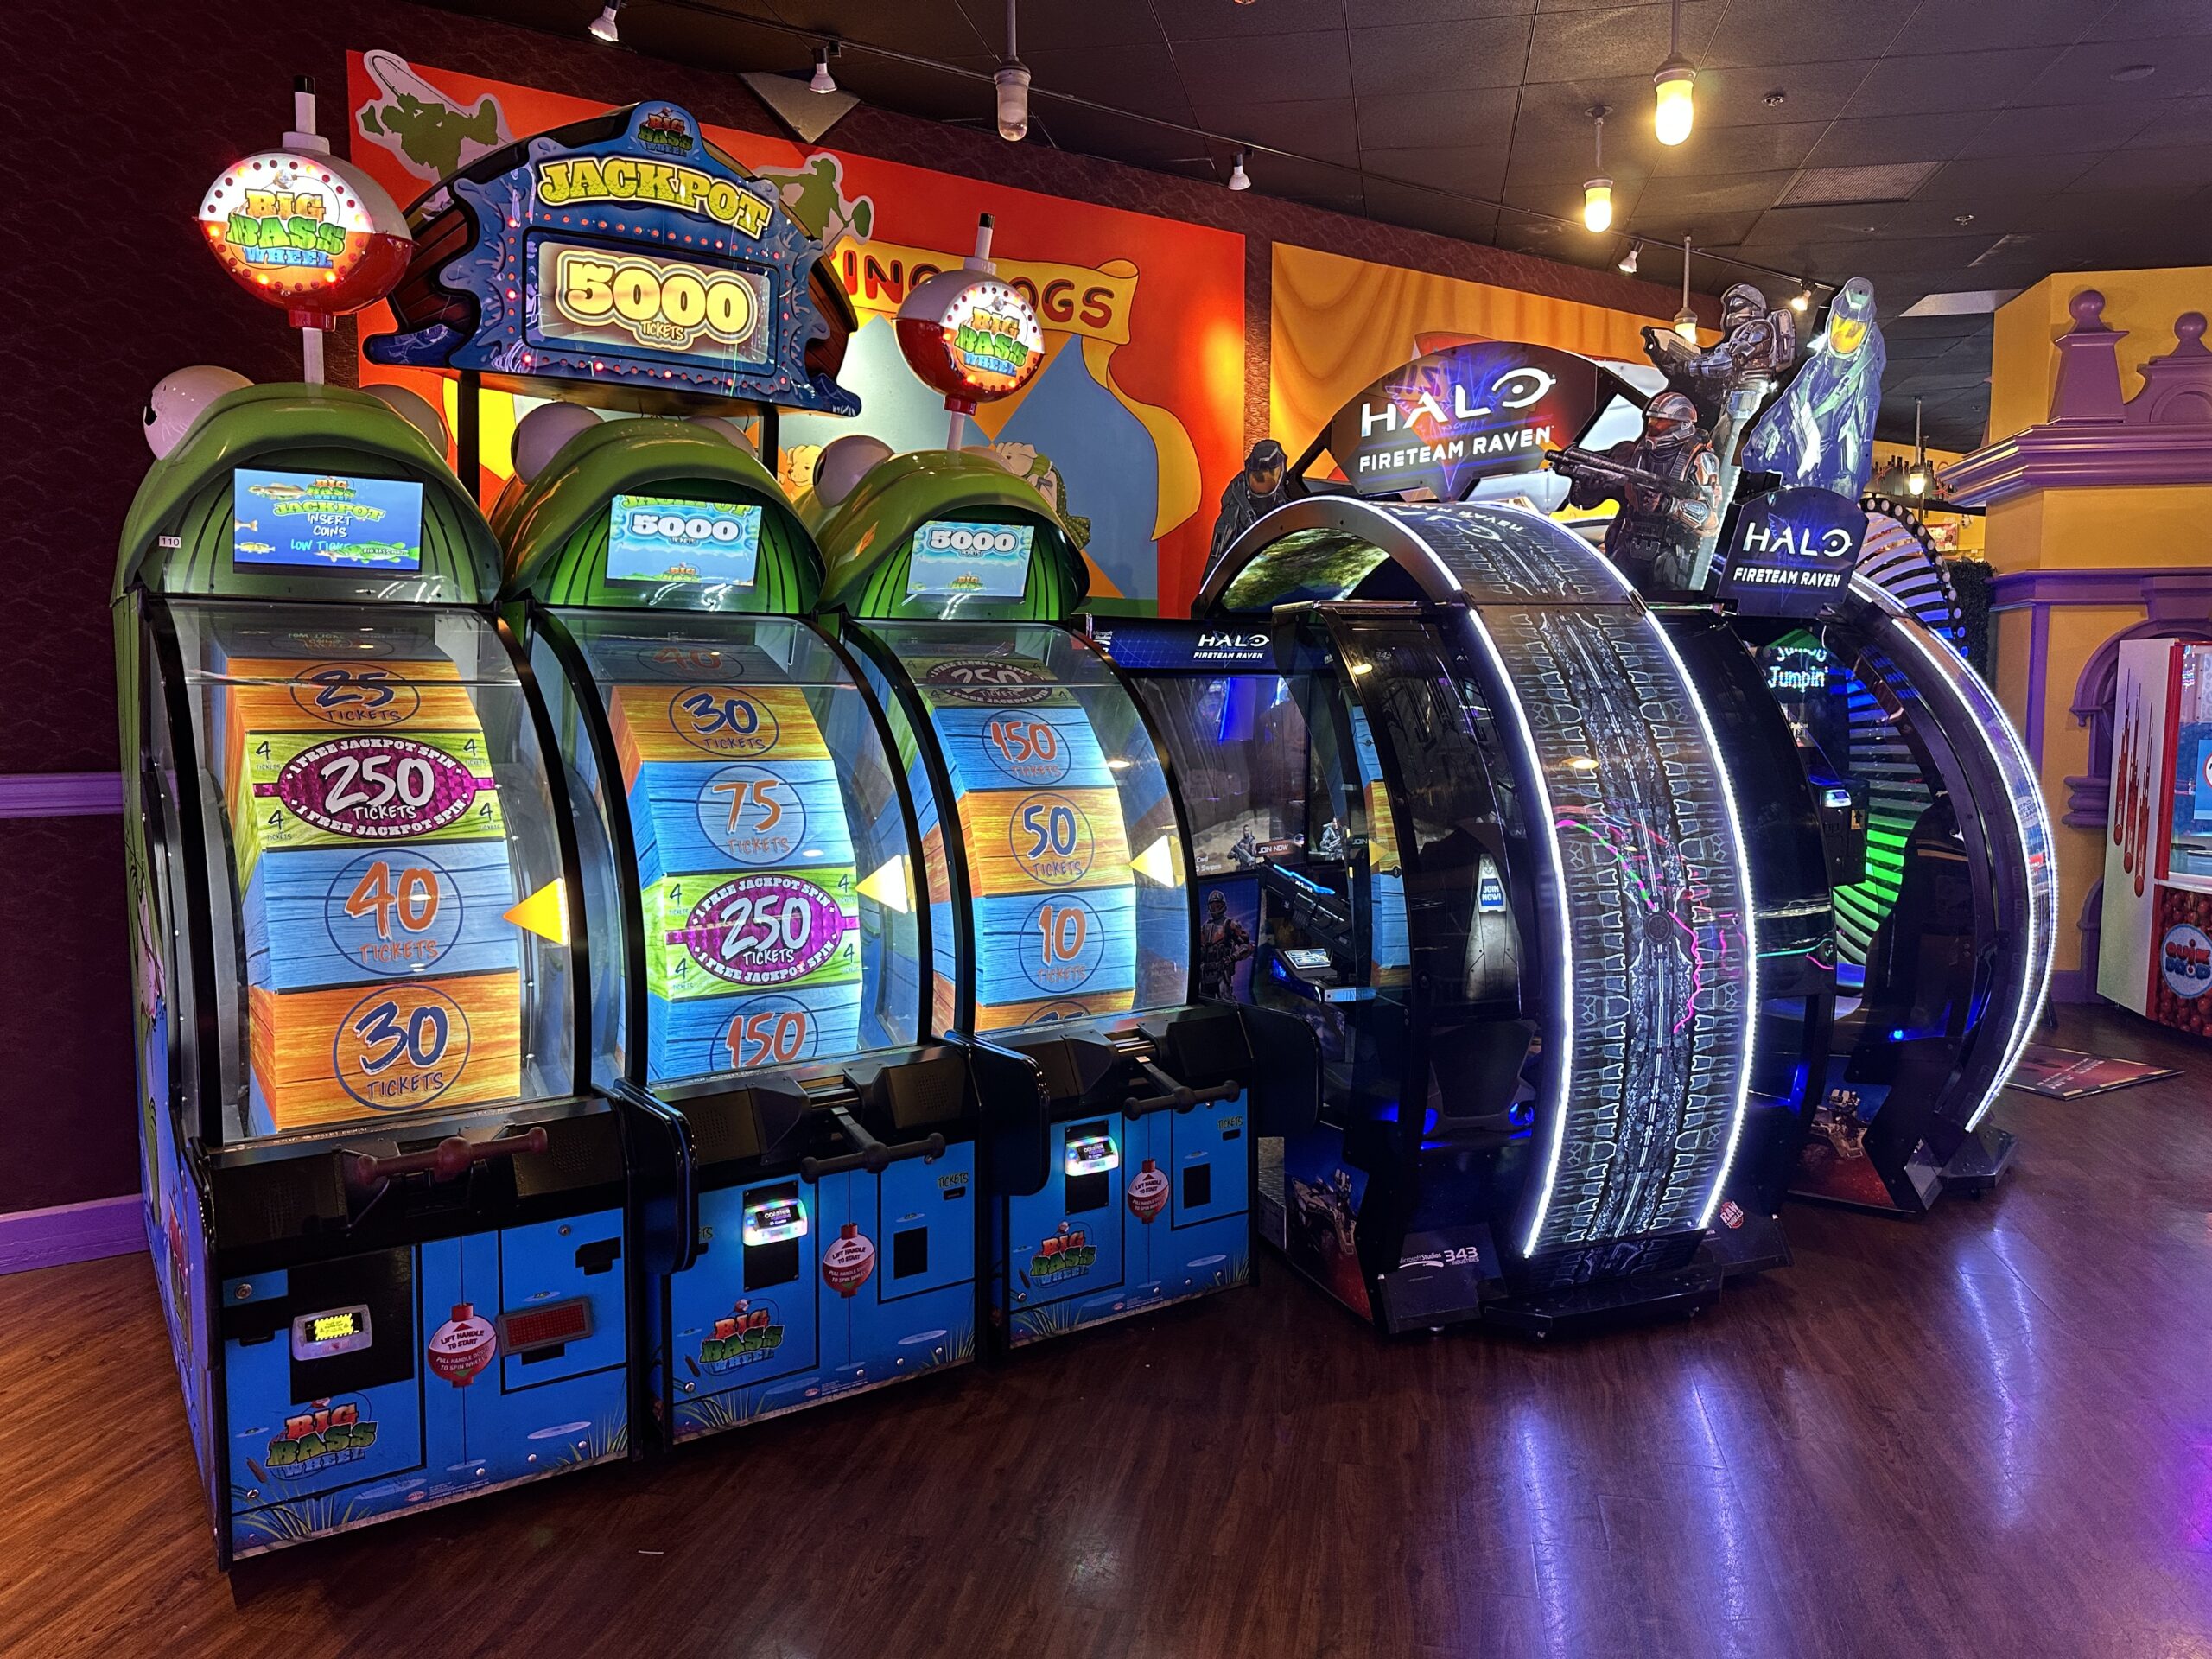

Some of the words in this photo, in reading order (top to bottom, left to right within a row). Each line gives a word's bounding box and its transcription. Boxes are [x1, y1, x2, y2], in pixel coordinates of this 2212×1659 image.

[648, 113, 685, 134] BIG
[638, 125, 693, 151] BASS
[645, 142, 687, 157] WHEEL
[245, 188, 327, 219] BIG
[540, 159, 772, 238] JACKPOT
[226, 213, 346, 256] BASS
[243, 247, 333, 269] WHEEL
[566, 261, 749, 333] 5000
[640, 321, 685, 340] TICKETS
[970, 307, 1020, 340] BIG
[955, 323, 1029, 367] BASS
[963, 353, 1017, 377] WHEEL
[1361, 367, 1556, 437] HALO
[1360, 440, 1465, 473] FIRETEAM
[1472, 426, 1552, 455] RAVEN
[273, 500, 386, 522] JACKPOT
[308, 512, 353, 526] INSERT
[313, 525, 347, 537] COINS
[632, 514, 739, 541] 5000
[162, 537, 179, 546] 110
[290, 539, 313, 551] LOW
[930, 530, 1016, 552] 5000
[1743, 522, 1853, 557] HALO
[1733, 567, 1797, 585] FIRETEAM
[1800, 571, 1841, 588] RAVEN
[1198, 634, 1269, 647] HALO
[652, 647, 723, 671] 40
[313, 670, 396, 708] 25
[950, 669, 1026, 692] 250
[326, 709, 402, 721] TICKETS
[682, 693, 760, 735] 30
[256, 741, 271, 760] 4
[298, 743, 338, 767] FREE
[341, 737, 416, 753] JACKPOT
[418, 746, 456, 770] SPIN
[463, 738, 478, 757] 4
[702, 737, 766, 750] TICKETS
[990, 721, 1057, 763] 150
[1011, 764, 1062, 779] TICKETS
[321, 755, 435, 815] 250
[308, 810, 353, 833] FREE
[356, 820, 434, 836] JACKPOT
[433, 799, 467, 826] SPIN
[352, 804, 417, 820] TICKETS
[479, 802, 493, 823] 4
[712, 779, 782, 835] 75
[267, 810, 284, 830] 4
[1023, 804, 1077, 861] 50
[727, 836, 791, 855] TICKETS
[1033, 861, 1084, 879] TICKETS
[669, 883, 683, 906] 4
[704, 883, 738, 910] FREE
[738, 877, 801, 891] JACKPOT
[801, 884, 830, 908] SPIN
[837, 873, 850, 893] 4
[344, 861, 441, 940] 40
[720, 895, 812, 963] 250
[1039, 905, 1087, 966] 10
[359, 939, 439, 963] TICKETS
[704, 957, 743, 981] FREE
[744, 964, 804, 982] JACKPOT
[807, 939, 836, 966] SPIN
[742, 948, 796, 967] TICKETS
[842, 942, 855, 963] 4
[674, 957, 688, 980] 4
[1037, 964, 1087, 983] TICKETS
[353, 1001, 449, 1076] 30
[725, 1011, 807, 1069] 150
[367, 1071, 446, 1099] TICKETS
[1217, 1116, 1244, 1129] TICKETS
[938, 1173, 969, 1188] TICKETS
[1719, 1200, 1739, 1224] RAW
[832, 1250, 843, 1260] LIFT
[844, 1247, 866, 1255] HANDLE
[1041, 1230, 1085, 1256] BIG
[1444, 1246, 1478, 1262] 343
[845, 1254, 861, 1262] START
[1029, 1245, 1097, 1276] BASS
[1452, 1256, 1480, 1266] INDUSTRIES
[714, 1308, 770, 1339] BIG
[441, 1334, 456, 1344] LIFT
[456, 1330, 484, 1340] HANDLE
[457, 1338, 478, 1348] START
[699, 1325, 785, 1363] BASS
[450, 1354, 473, 1363] HANDLE
[712, 1351, 775, 1373] WHEEL
[285, 1402, 358, 1439] BIG
[265, 1421, 378, 1469] BASS
[279, 1448, 366, 1479] WHEEL
